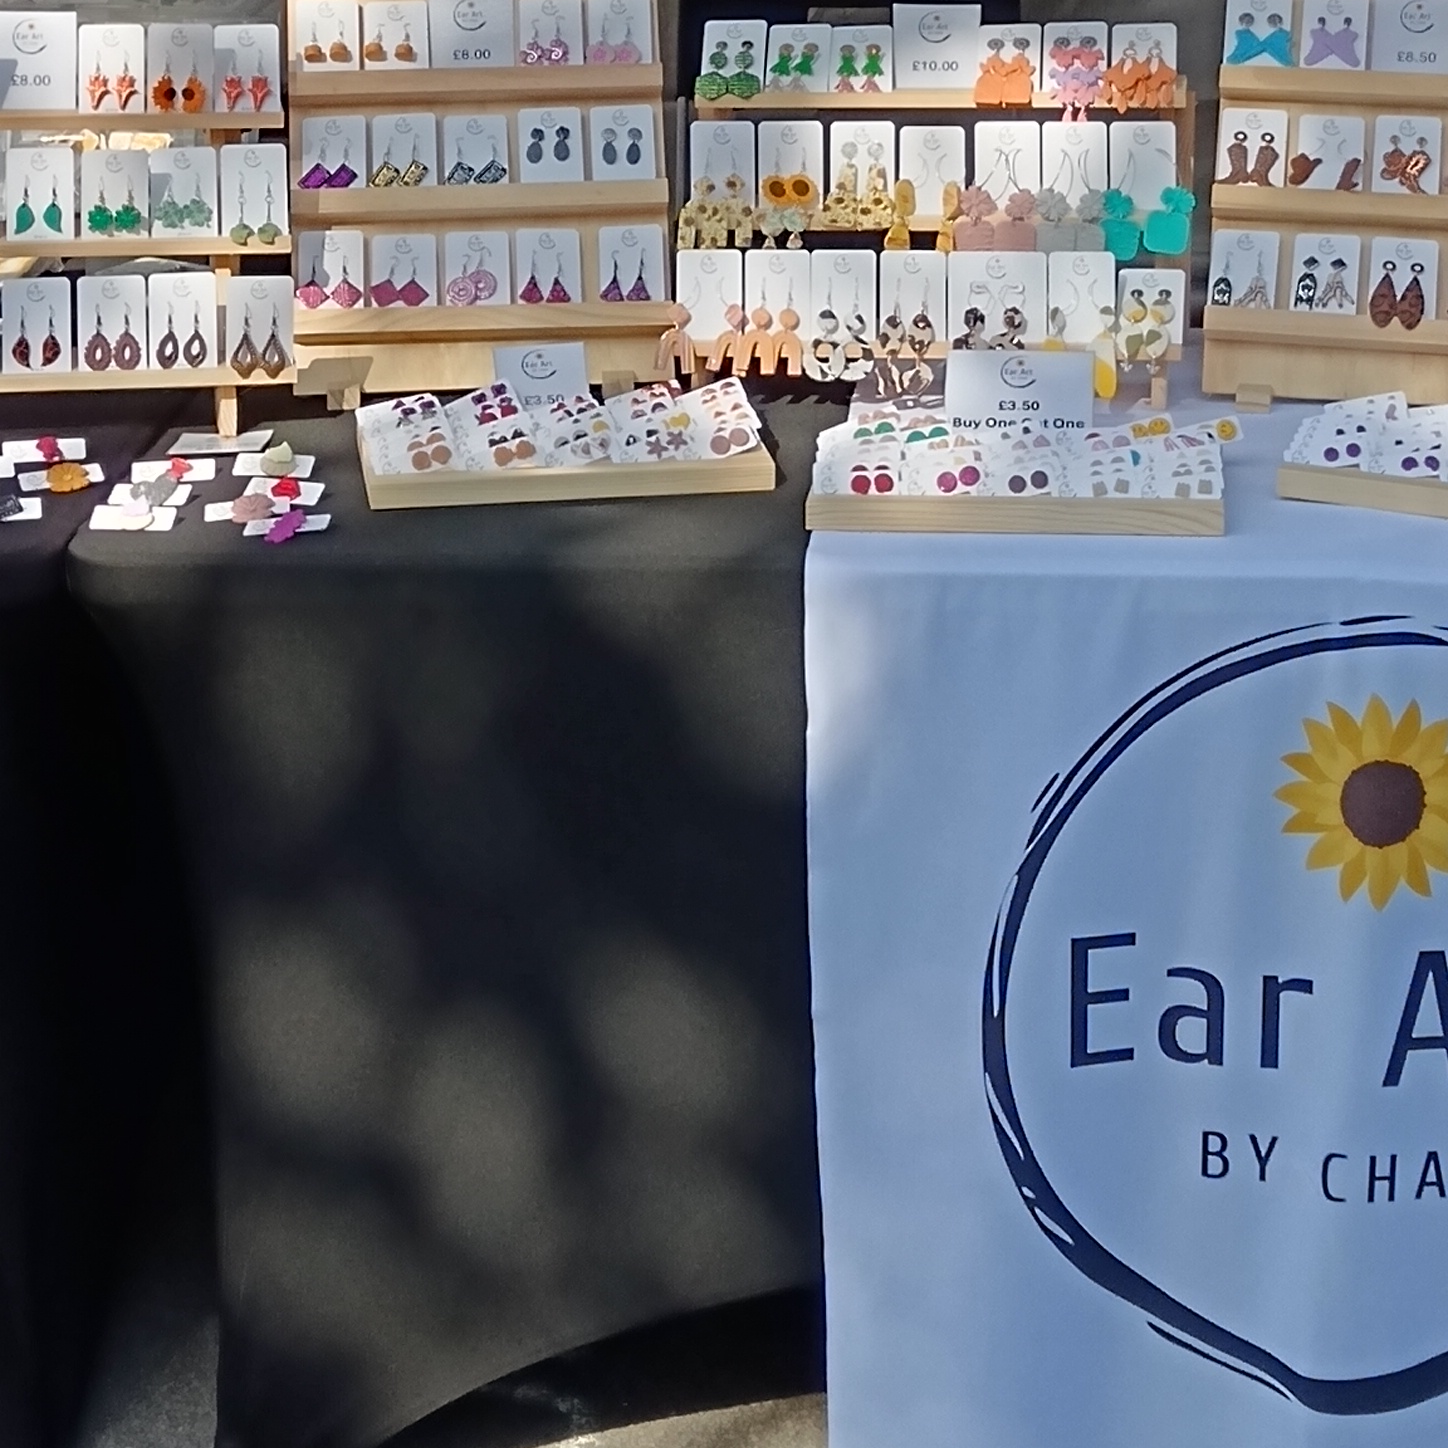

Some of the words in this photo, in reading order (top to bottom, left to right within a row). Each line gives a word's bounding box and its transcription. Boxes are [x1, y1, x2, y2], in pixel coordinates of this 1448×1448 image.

[453, 49, 490, 60] £8.00
[1398, 51, 1436, 62] £8.50
[912, 60, 958, 71] £10.00
[12, 74, 50, 86] £8.00
[998, 400, 1040, 410] £3.50
[953, 417, 981, 430] Buy
[1053, 418, 1085, 429] One
[1071, 932, 1313, 1069] Ear
[1201, 1131, 1279, 1182] BY
